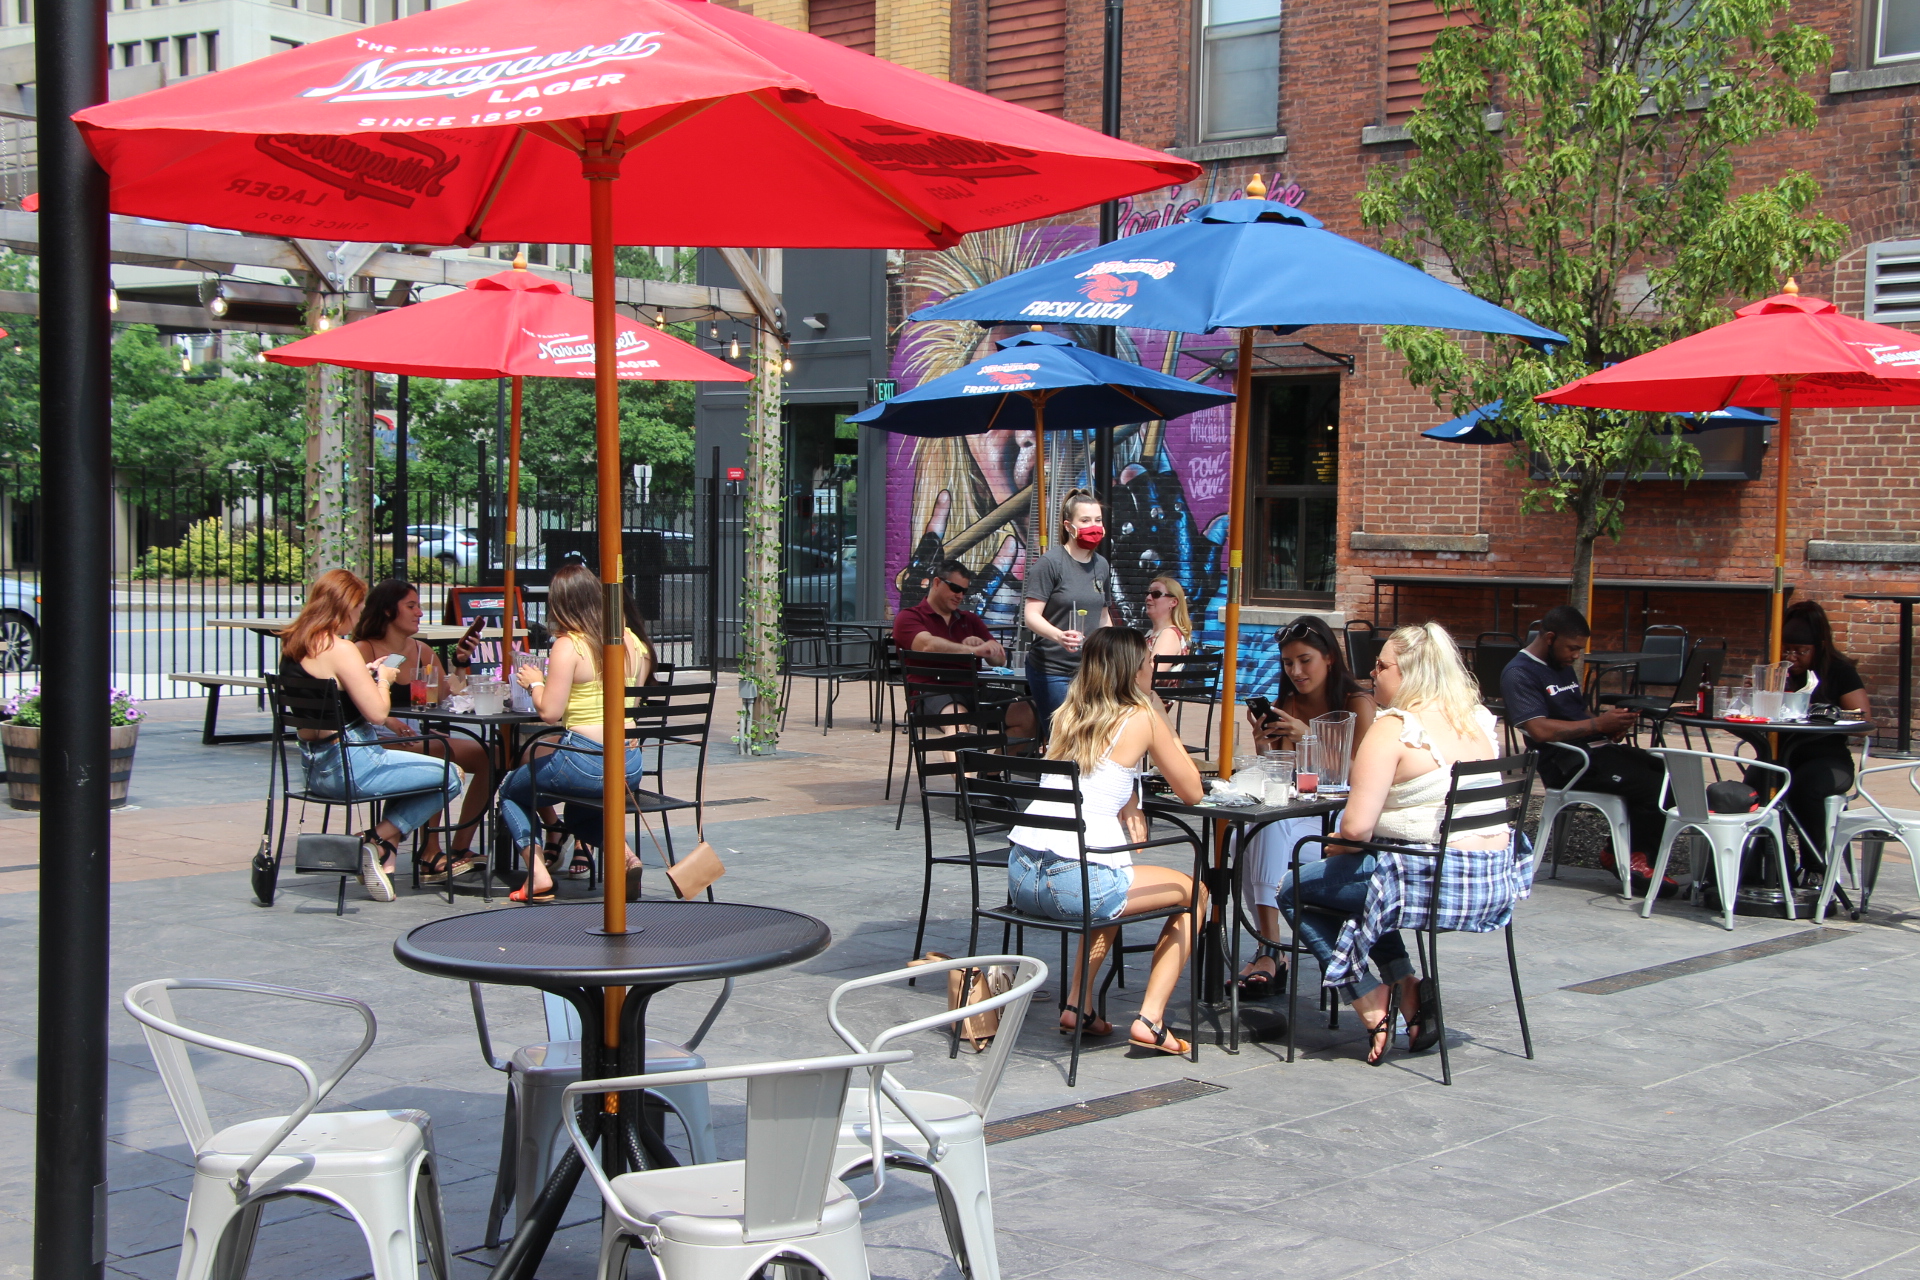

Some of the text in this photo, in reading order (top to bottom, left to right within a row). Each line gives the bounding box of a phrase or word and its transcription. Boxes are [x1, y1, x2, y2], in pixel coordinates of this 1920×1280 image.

[356, 38, 397, 54] THE
[296, 31, 664, 103] Narragansett
[487, 73, 626, 103] LAGER
[357, 106, 543, 127] SINCE 1890
[1019, 300, 1134, 320] FRESH CATCH
[537, 330, 649, 365] Narragett
[616, 360, 660, 369] AGER
[878, 382, 895, 401] EXIT
[962, 381, 1036, 394] FRESH CATCH
[1188, 450, 1228, 481] POW!
[1545, 681, 1579, 696] Champi
